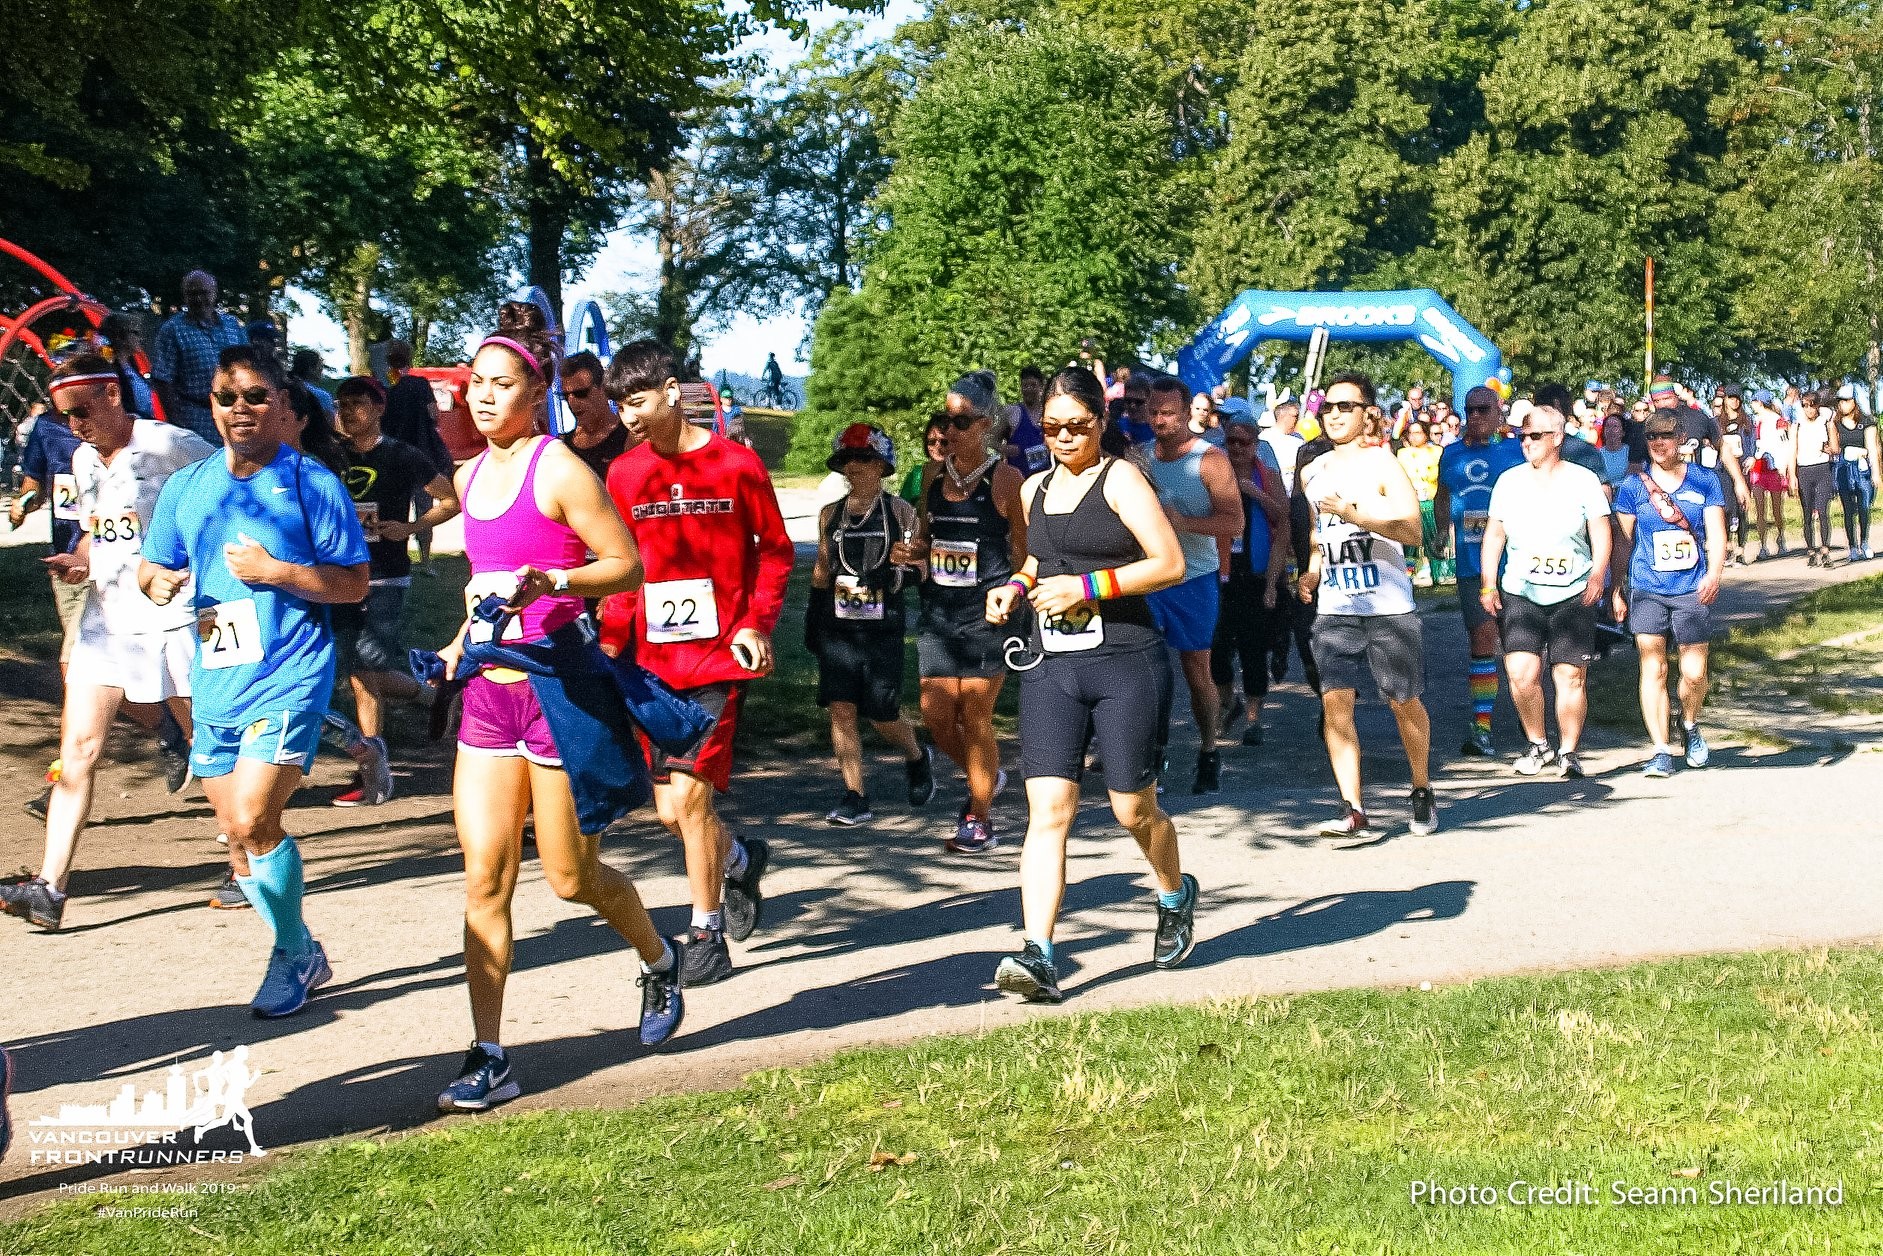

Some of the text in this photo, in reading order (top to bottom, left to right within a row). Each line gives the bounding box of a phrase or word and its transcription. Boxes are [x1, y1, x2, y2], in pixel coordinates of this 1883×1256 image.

[1661, 542, 1691, 561] 357
[933, 553, 971, 575] 109
[1529, 556, 1568, 576] 255
[662, 598, 699, 628] 22
[208, 622, 240, 653] 21
